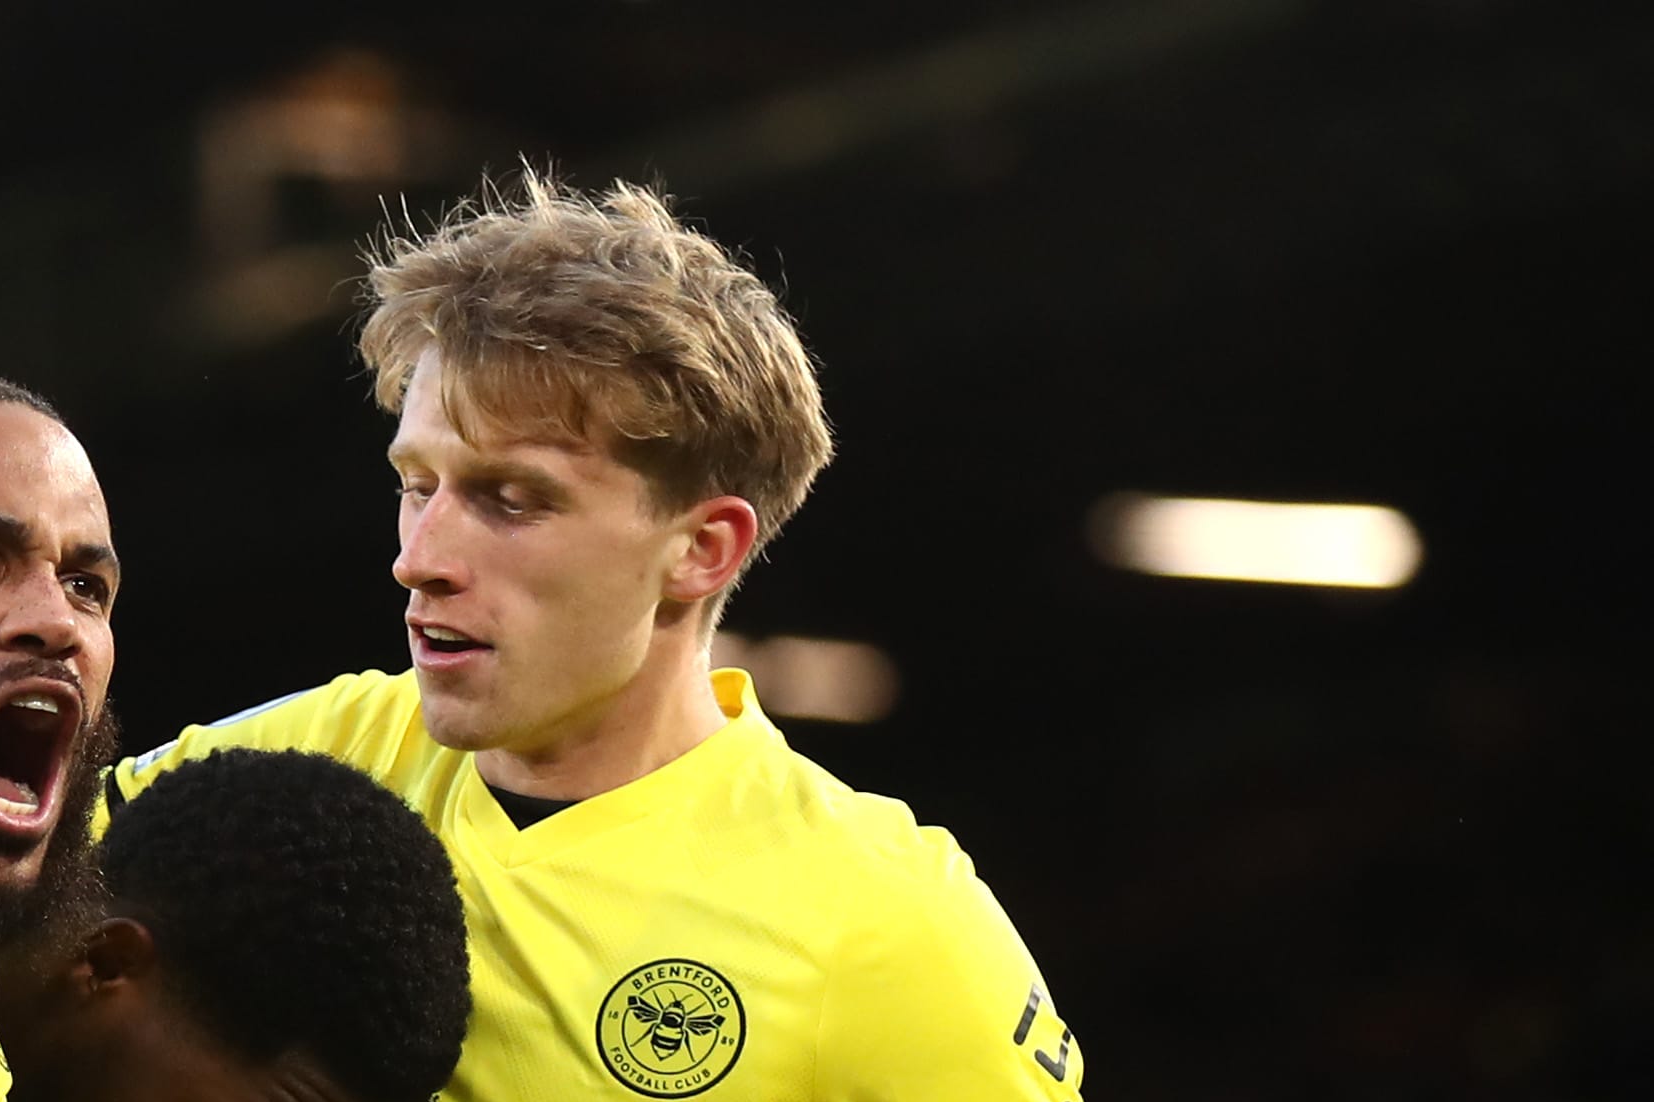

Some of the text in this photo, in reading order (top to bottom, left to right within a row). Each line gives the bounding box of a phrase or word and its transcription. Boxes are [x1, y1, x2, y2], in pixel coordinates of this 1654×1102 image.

[632, 966, 730, 1009] BRENTFORD
[610, 1046, 712, 1090] FOOTBALL CLUB
